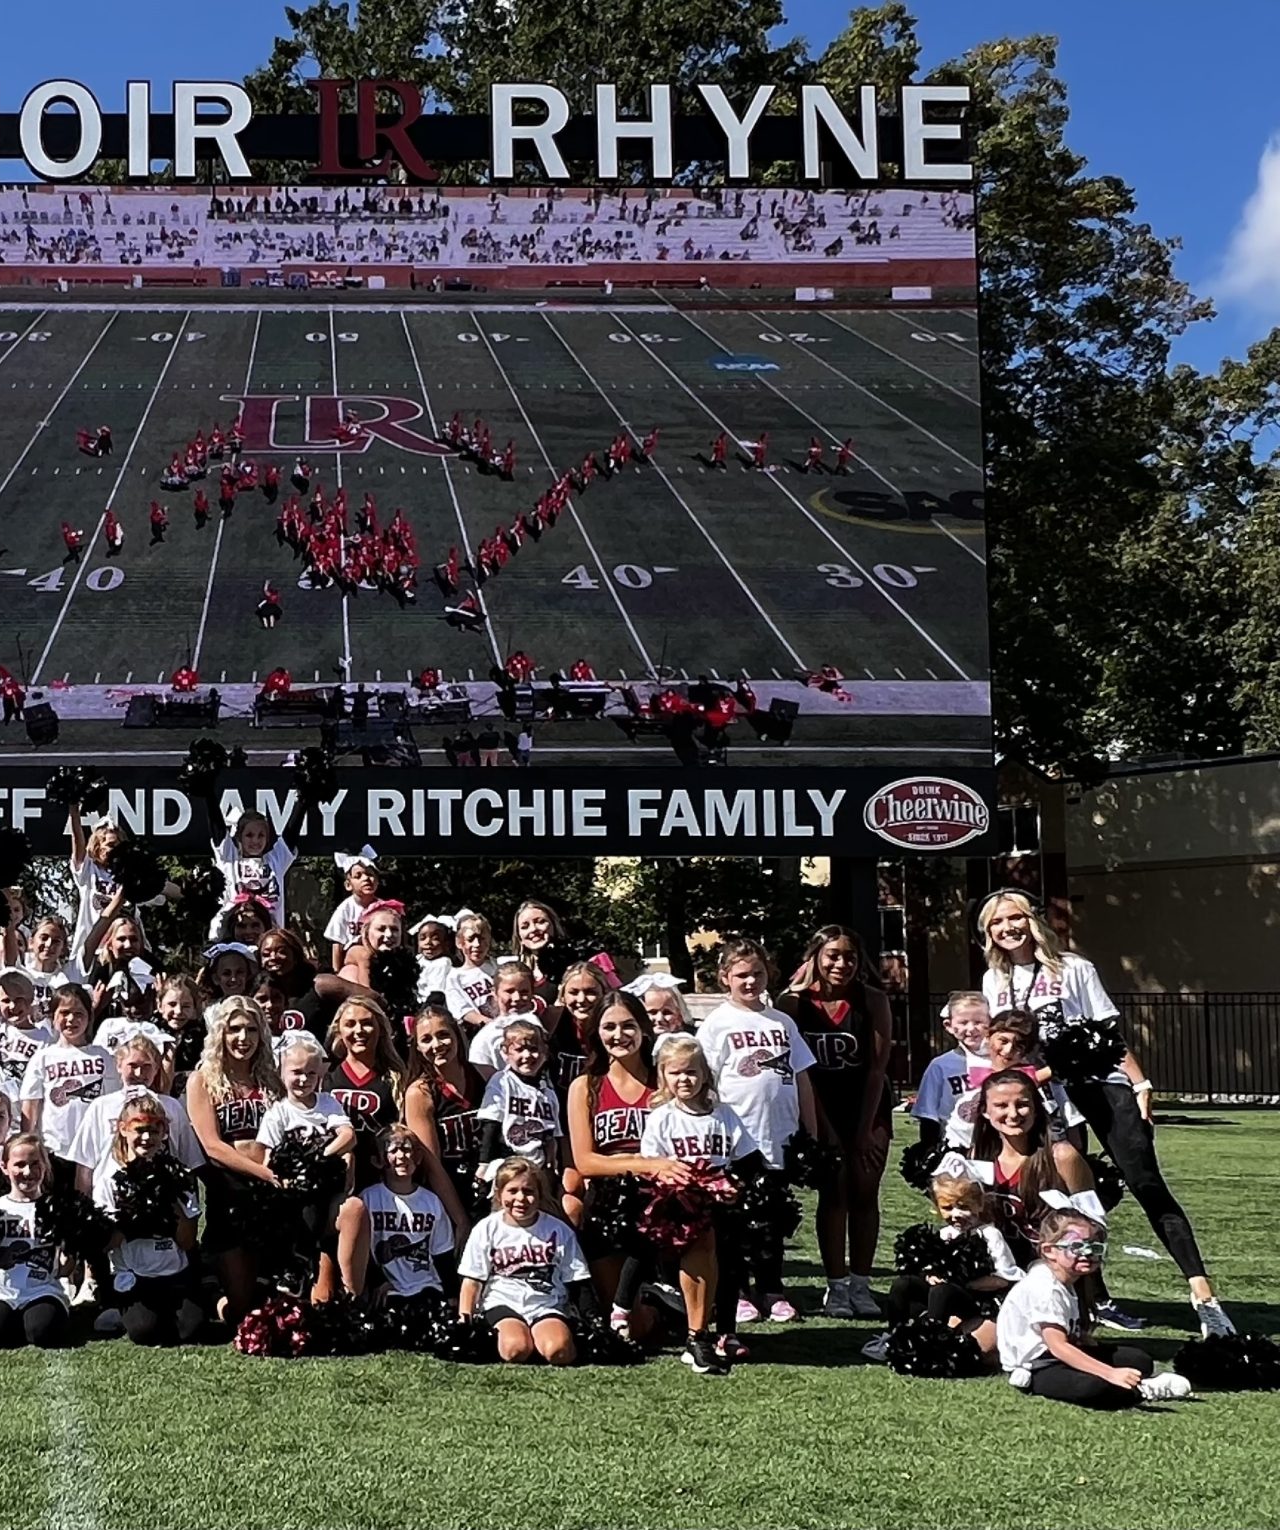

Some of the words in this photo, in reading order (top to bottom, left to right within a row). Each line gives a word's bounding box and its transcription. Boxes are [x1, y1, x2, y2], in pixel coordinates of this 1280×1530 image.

[307, 78, 441, 181] LR
[490, 81, 974, 181] RHYNE
[27, 566, 126, 593] 40
[561, 563, 654, 589] 40
[817, 563, 919, 589] 30
[366, 788, 608, 837] RITCHIE
[627, 788, 848, 837] FAMILY
[867, 793, 986, 829] Cheerwine
[463, 978, 494, 1001] BEA
[45, 1058, 105, 1081] BEARS
[508, 1096, 554, 1121] BEAR
[594, 1109, 649, 1148] BEA
[671, 1135, 732, 1158] BEARS
[372, 1210, 436, 1233] BEARS
